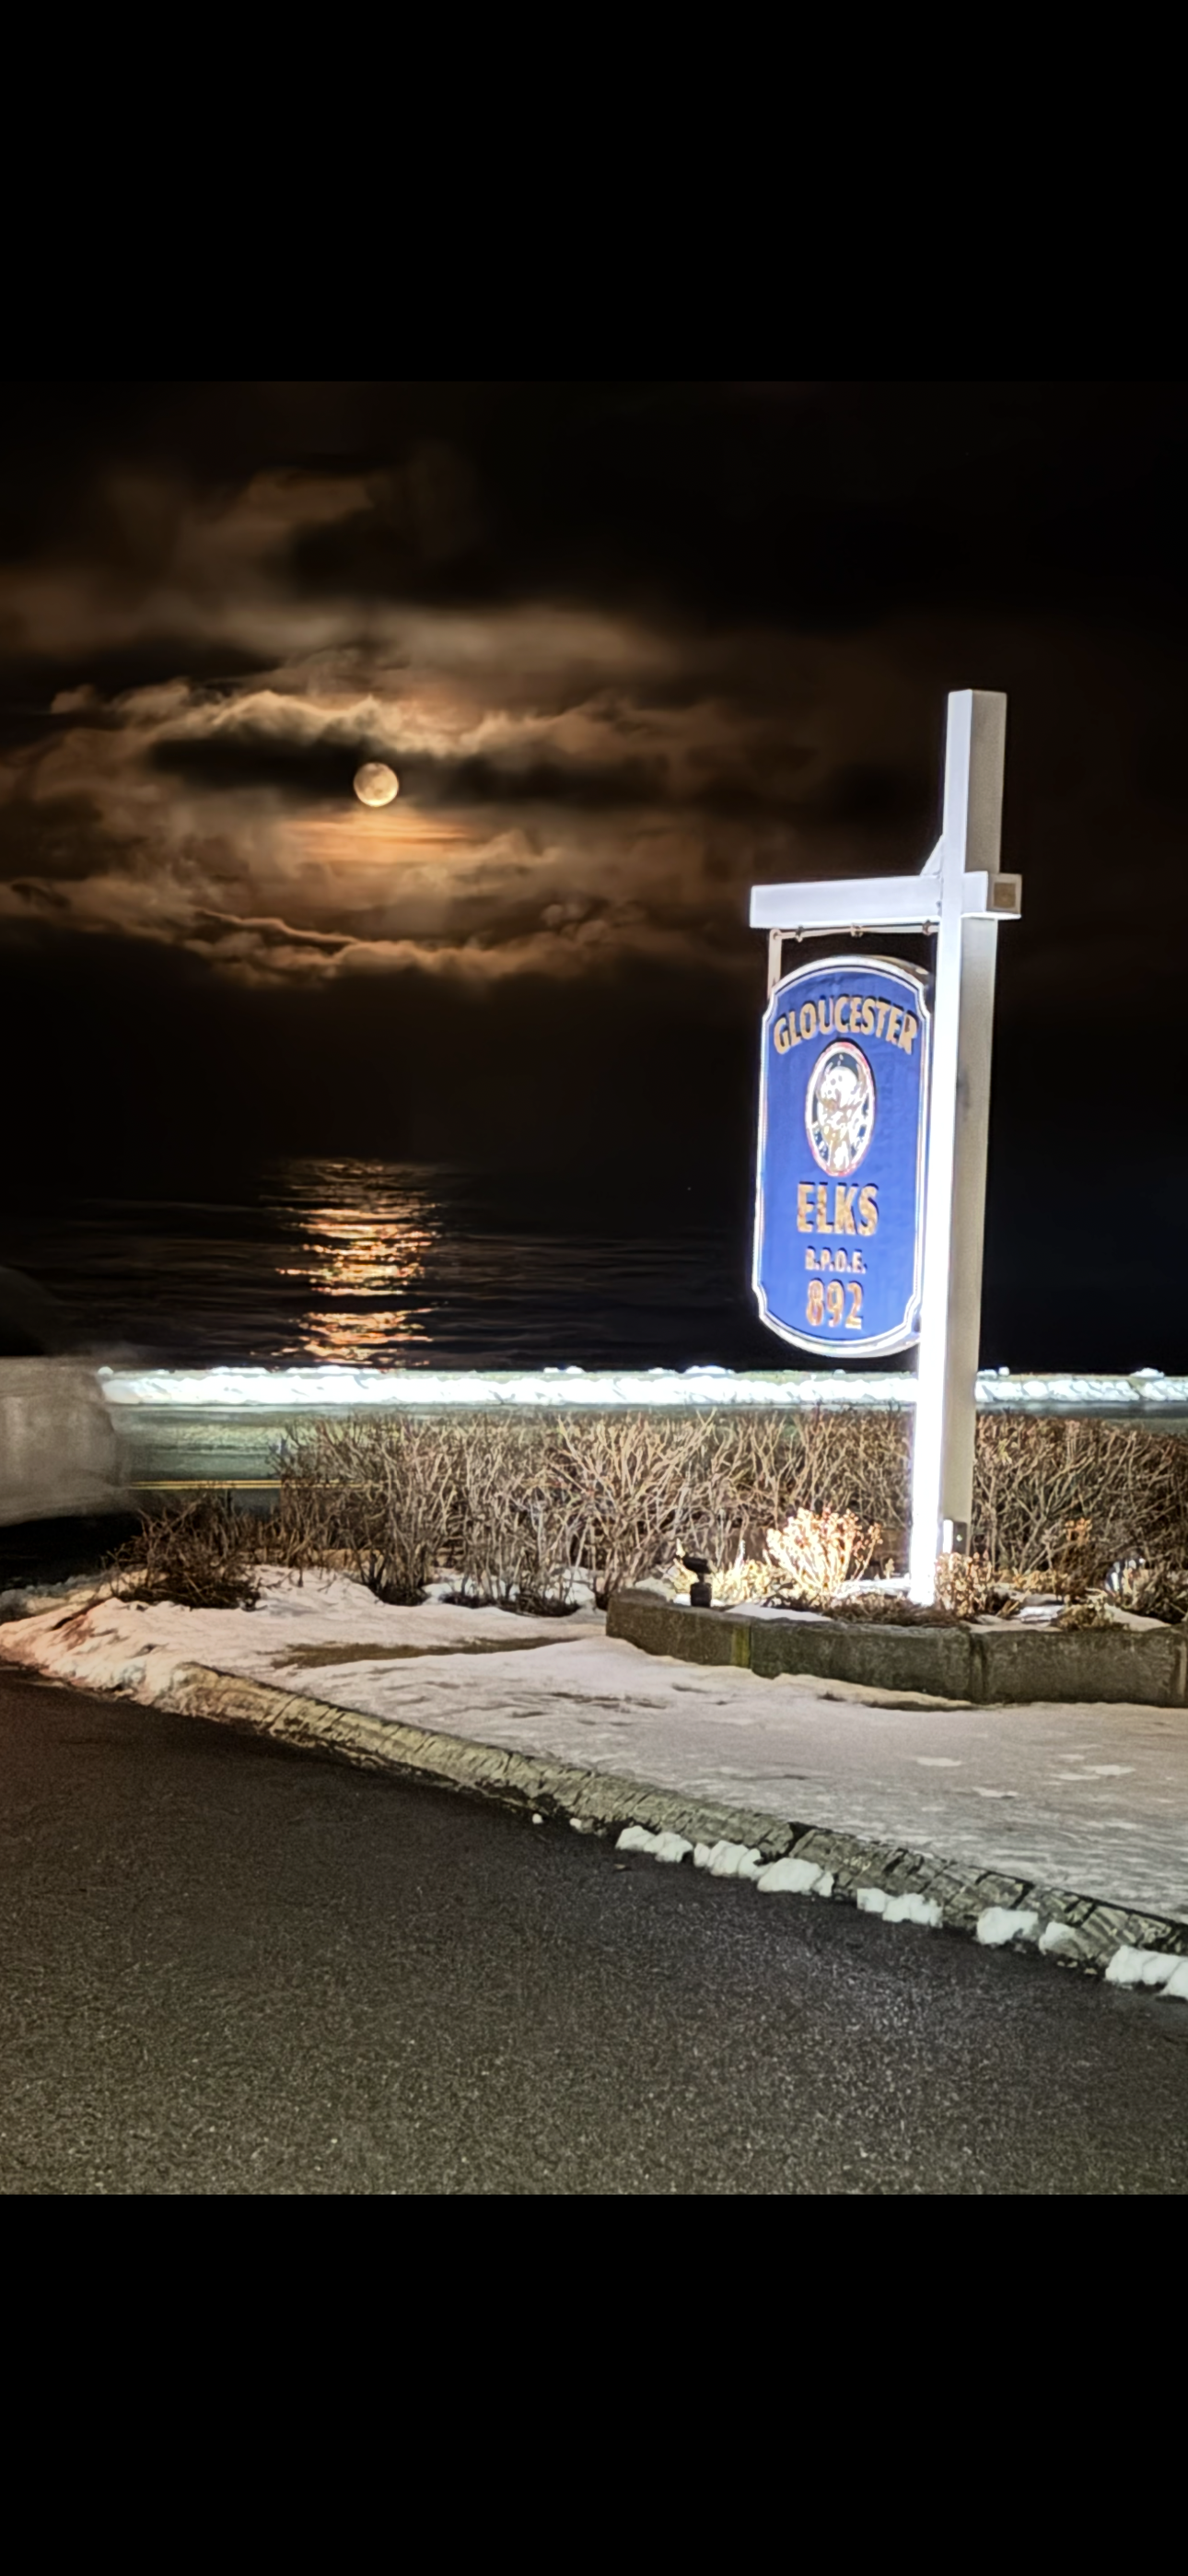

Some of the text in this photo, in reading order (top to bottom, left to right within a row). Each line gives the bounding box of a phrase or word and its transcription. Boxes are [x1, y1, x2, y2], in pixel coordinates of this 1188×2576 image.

[774, 994, 918, 1055] GLOUCESTER
[797, 1181, 879, 1236] ELKS
[805, 1247, 867, 1273] B.P.O.E.
[806, 1279, 864, 1329] 892
